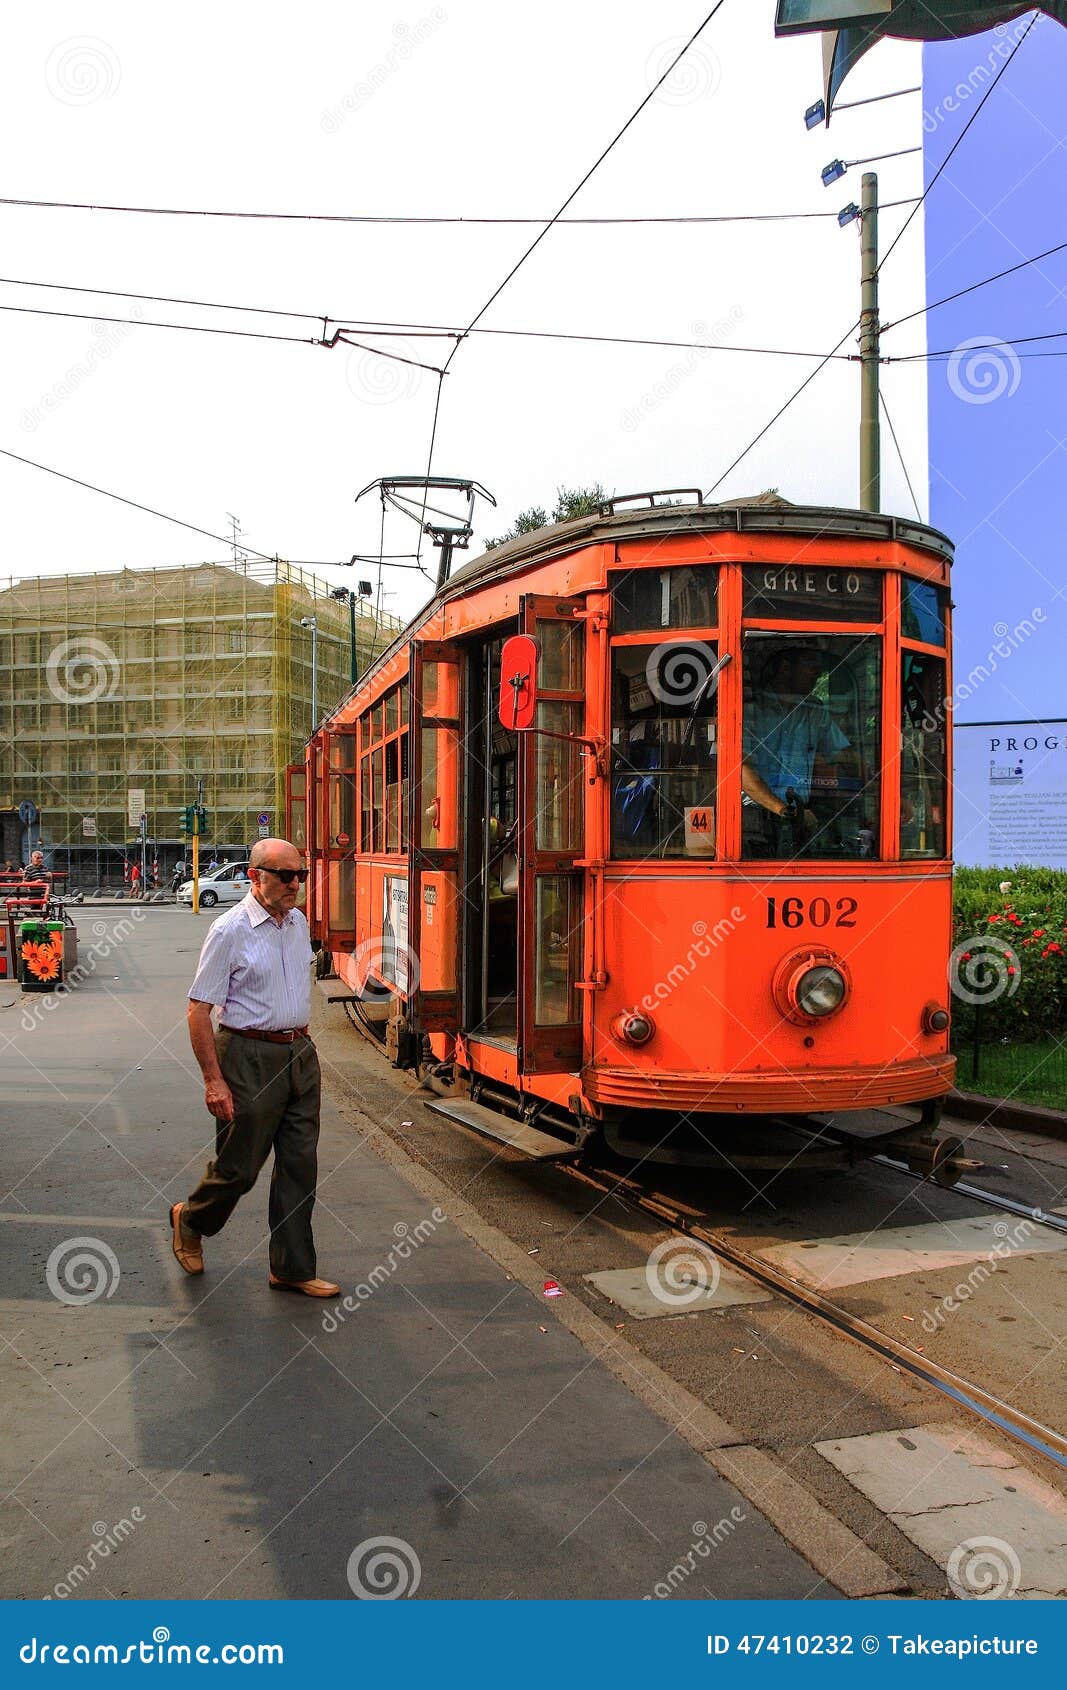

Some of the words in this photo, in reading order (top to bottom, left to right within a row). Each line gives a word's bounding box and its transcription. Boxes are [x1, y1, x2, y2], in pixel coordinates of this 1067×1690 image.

[764, 570, 860, 593] GRECO
[990, 737, 1067, 751] PROG
[692, 812, 707, 829] 44
[766, 897, 857, 928] 1602
